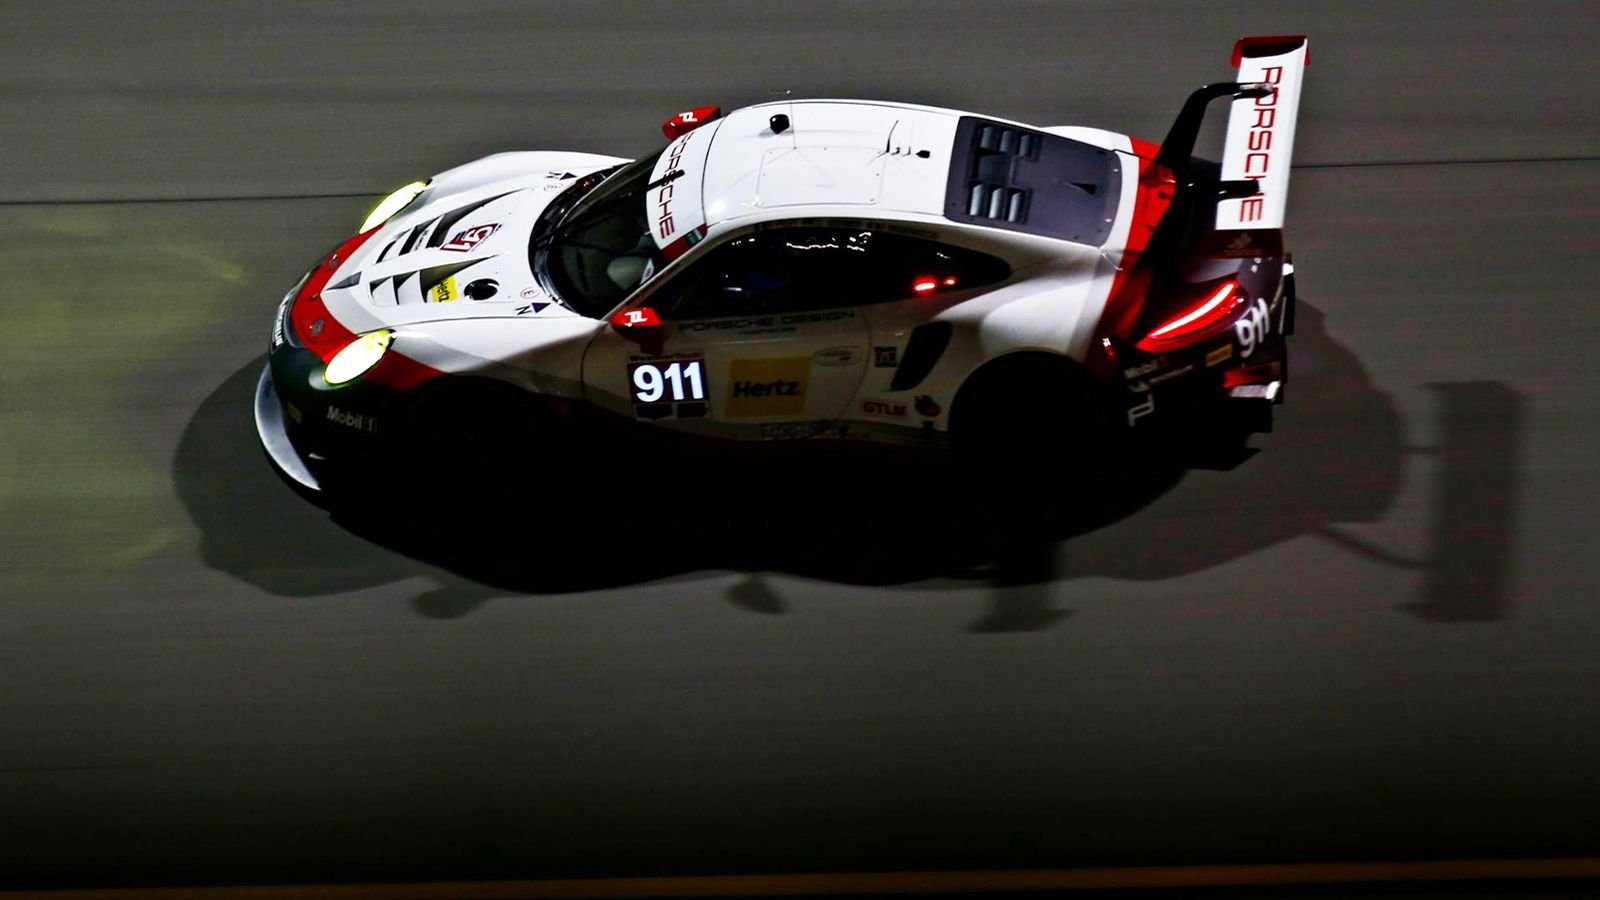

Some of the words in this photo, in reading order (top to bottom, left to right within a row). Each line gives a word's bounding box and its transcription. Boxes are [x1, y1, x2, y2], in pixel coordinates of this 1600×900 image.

[678, 318, 774, 331] PORSCHE
[781, 311, 855, 325] DESIGN
[1235, 297, 1271, 358] 911
[633, 361, 704, 403] 911
[733, 380, 799, 398] Hertz
[326, 404, 363, 430] Mobil
[863, 401, 906, 416] GTLM
